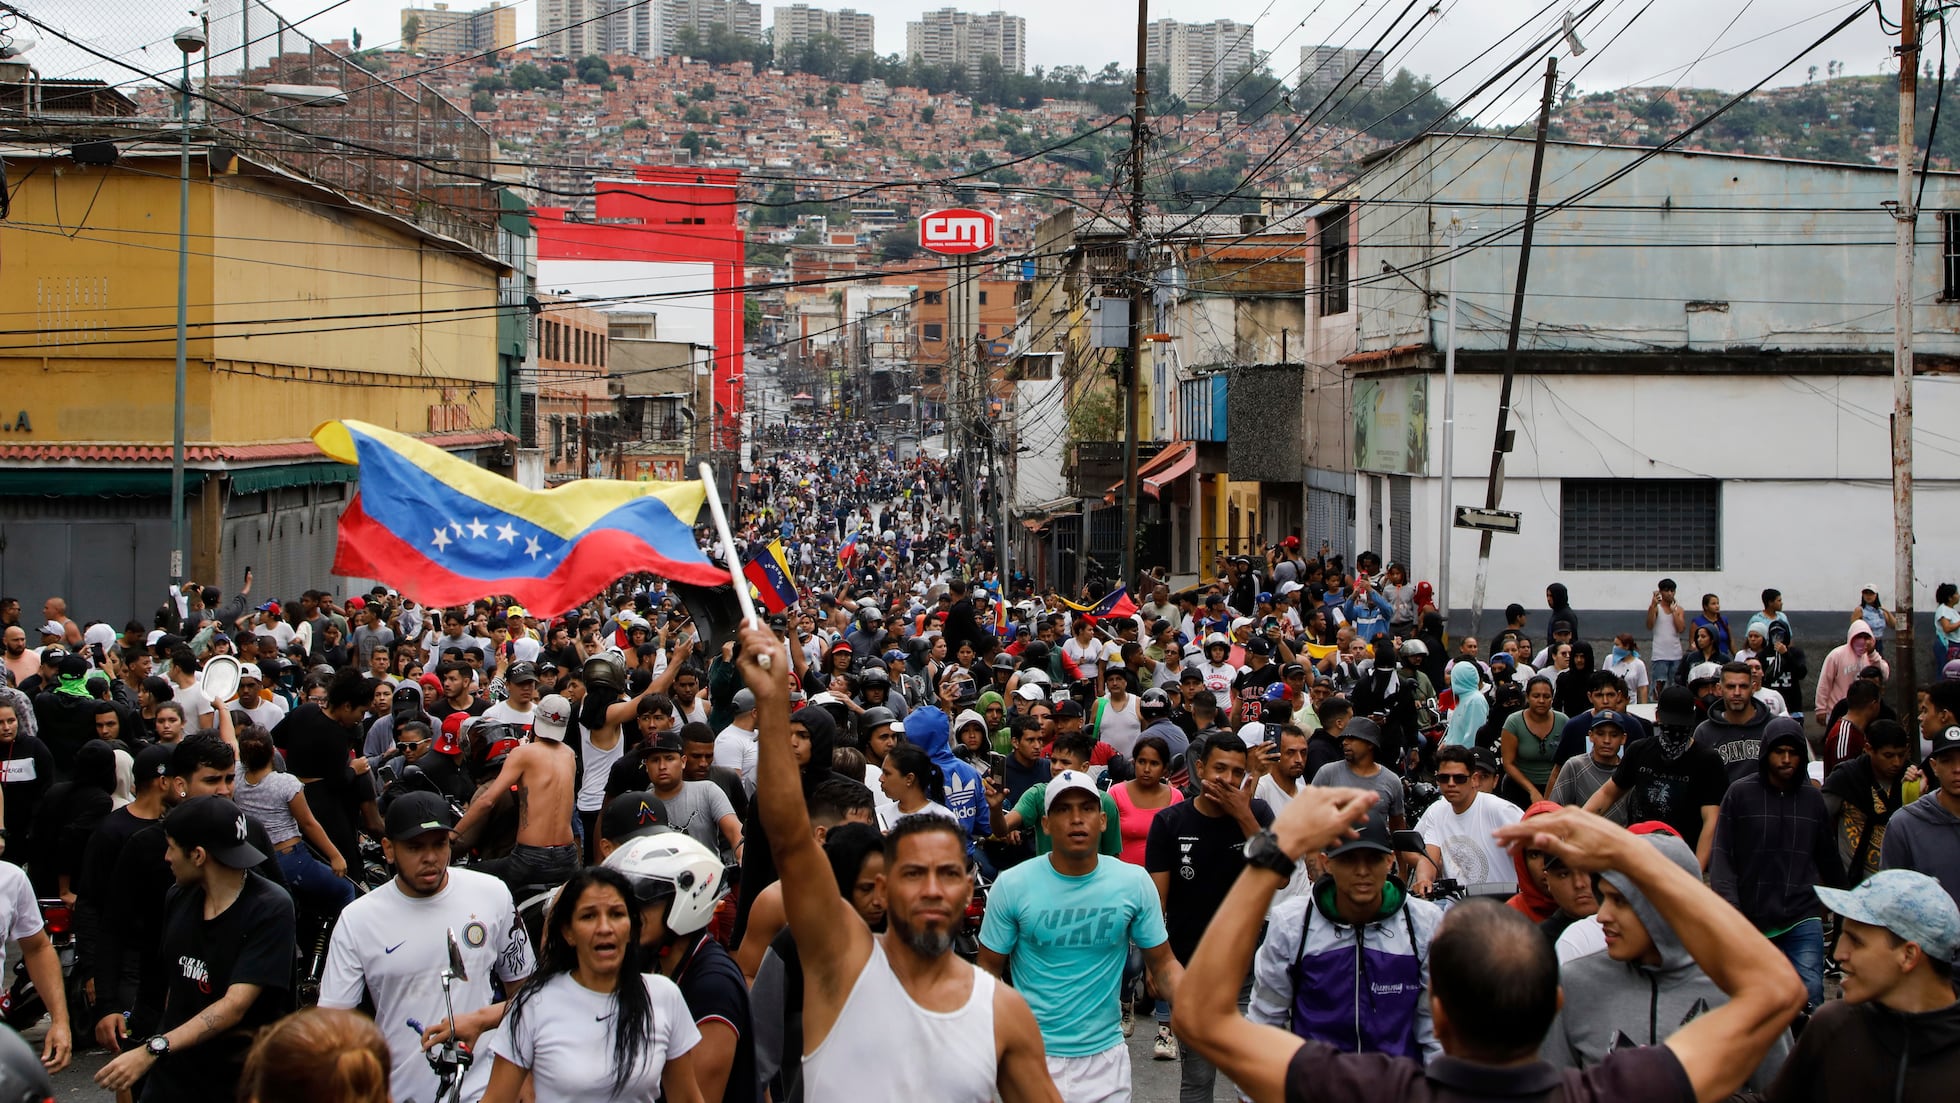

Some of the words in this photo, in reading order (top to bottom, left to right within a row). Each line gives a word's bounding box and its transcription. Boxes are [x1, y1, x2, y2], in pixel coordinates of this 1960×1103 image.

[0, 409, 33, 432] .A
[1240, 701, 1262, 722] 23
[234, 812, 248, 840] NY
[1029, 906, 1118, 948] NIKE
